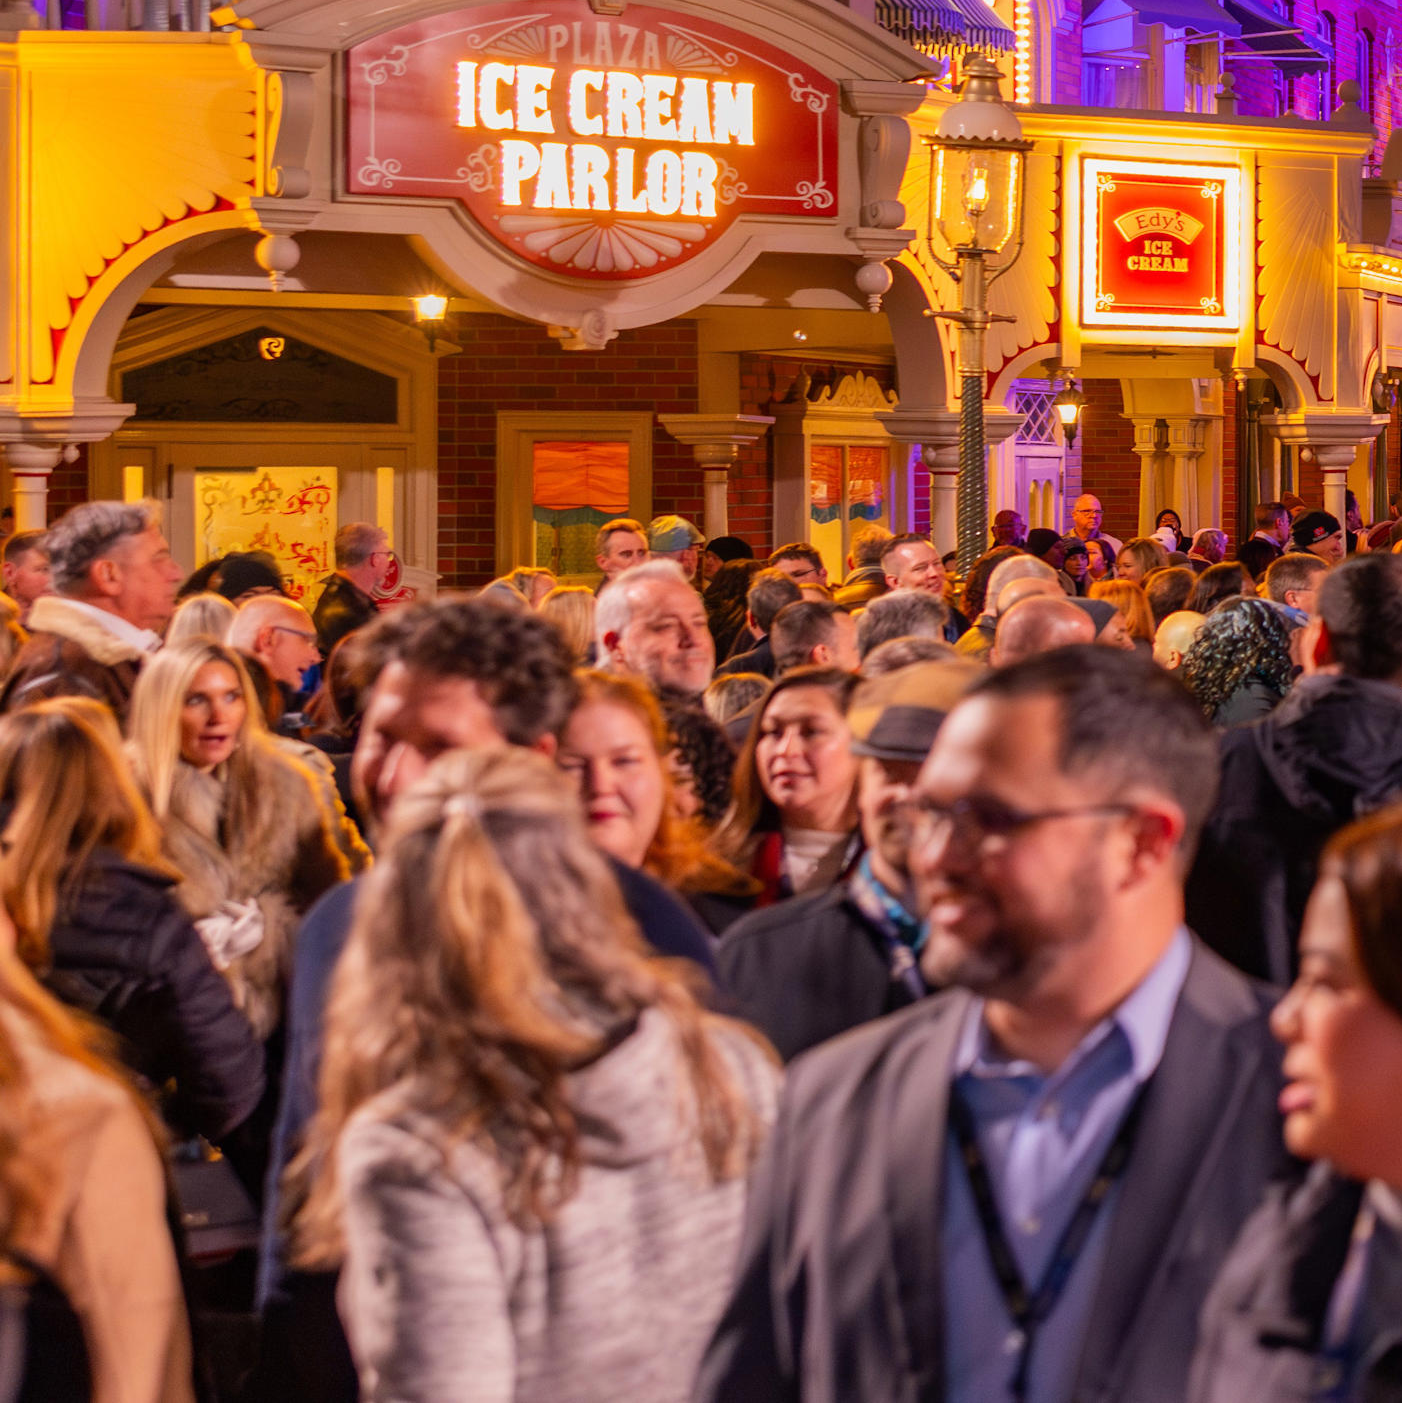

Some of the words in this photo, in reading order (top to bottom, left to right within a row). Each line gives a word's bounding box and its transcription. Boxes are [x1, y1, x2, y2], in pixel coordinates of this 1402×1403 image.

[548, 21, 662, 70] PLAZA
[456, 60, 556, 134] ICE
[568, 69, 756, 145] CREAM
[499, 139, 718, 217] PARLOR
[1135, 211, 1185, 232] Edy's
[1127, 255, 1189, 272] CREAM
[1143, 240, 1173, 255] ICE
